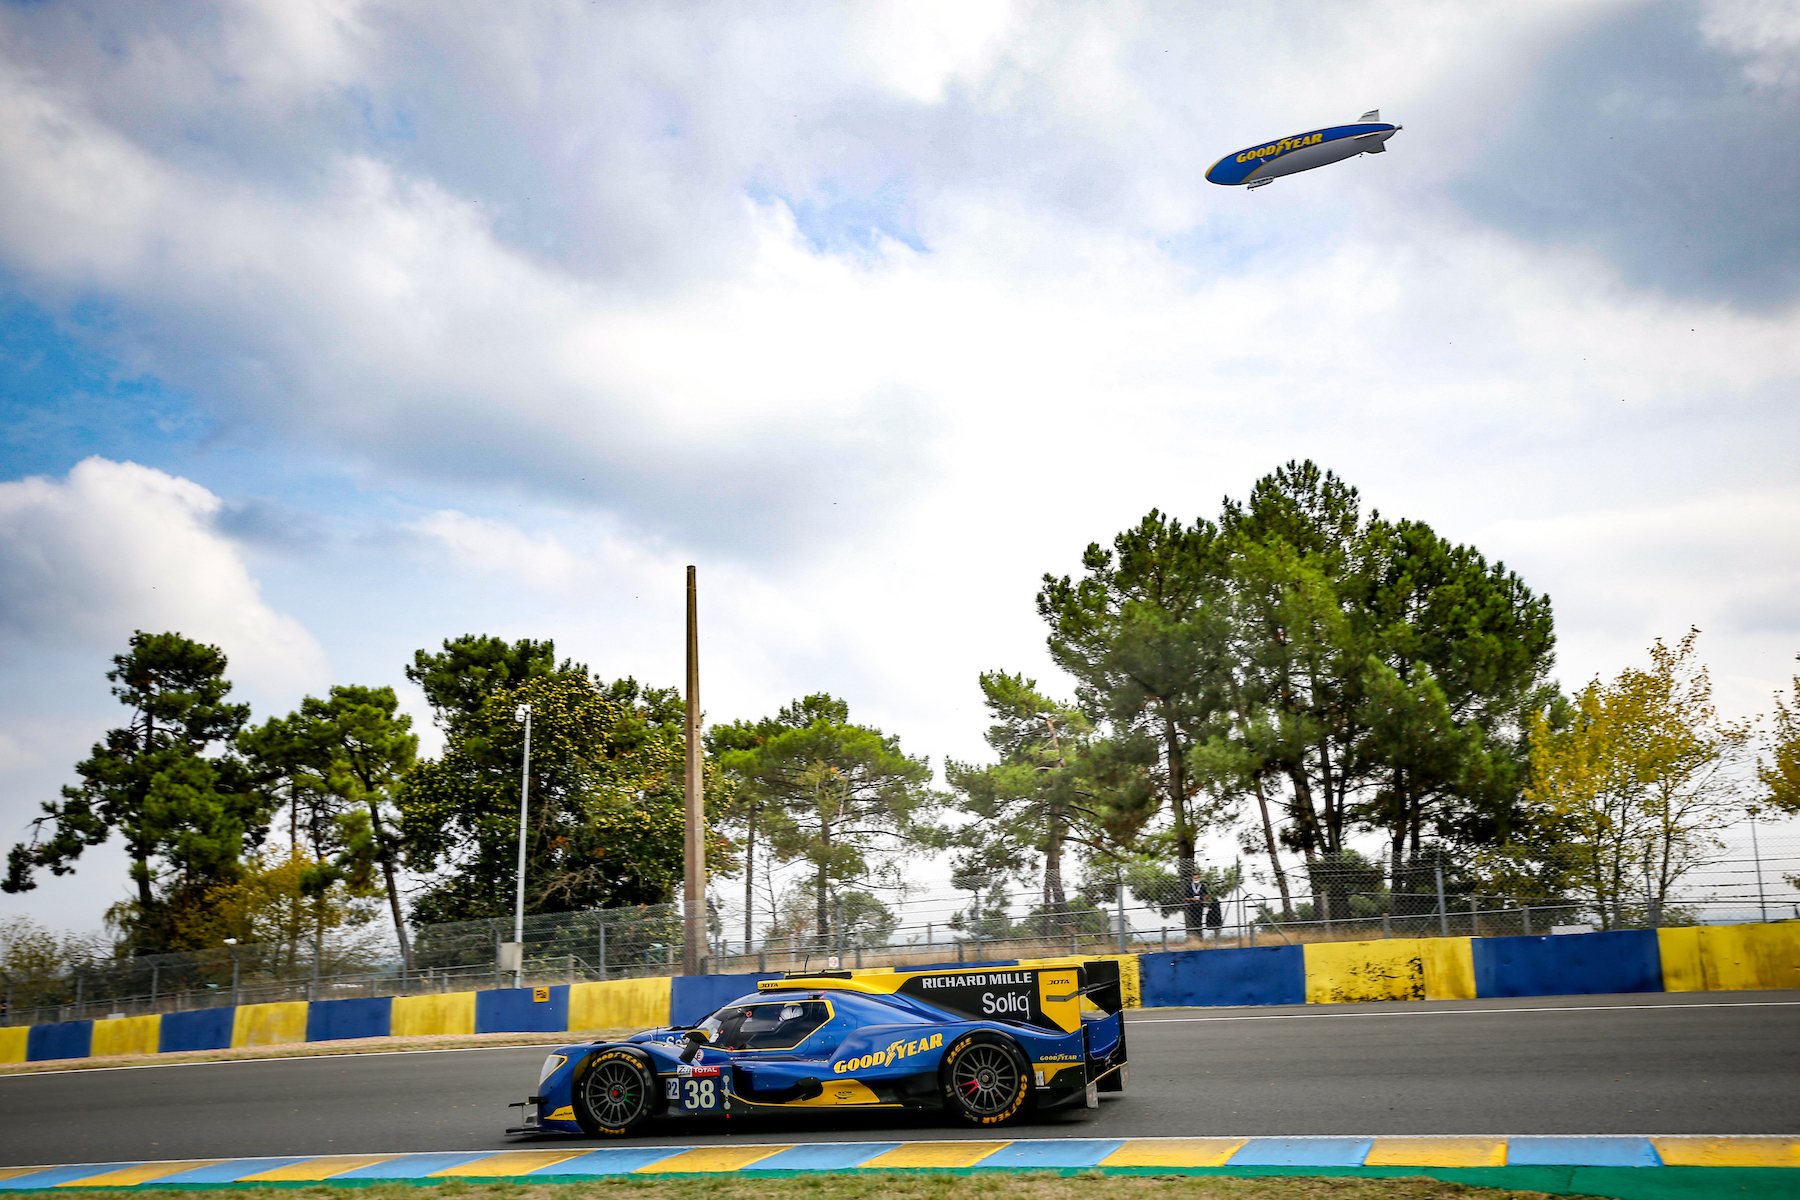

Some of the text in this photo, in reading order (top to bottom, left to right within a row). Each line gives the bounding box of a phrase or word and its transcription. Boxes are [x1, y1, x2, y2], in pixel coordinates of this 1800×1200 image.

[922, 972, 1032, 989] RICHARD MILLE
[982, 990, 1031, 1020] Soliq
[947, 1037, 972, 1065] EAGLE
[666, 1081, 678, 1096] P2
[684, 1079, 716, 1109] 38
